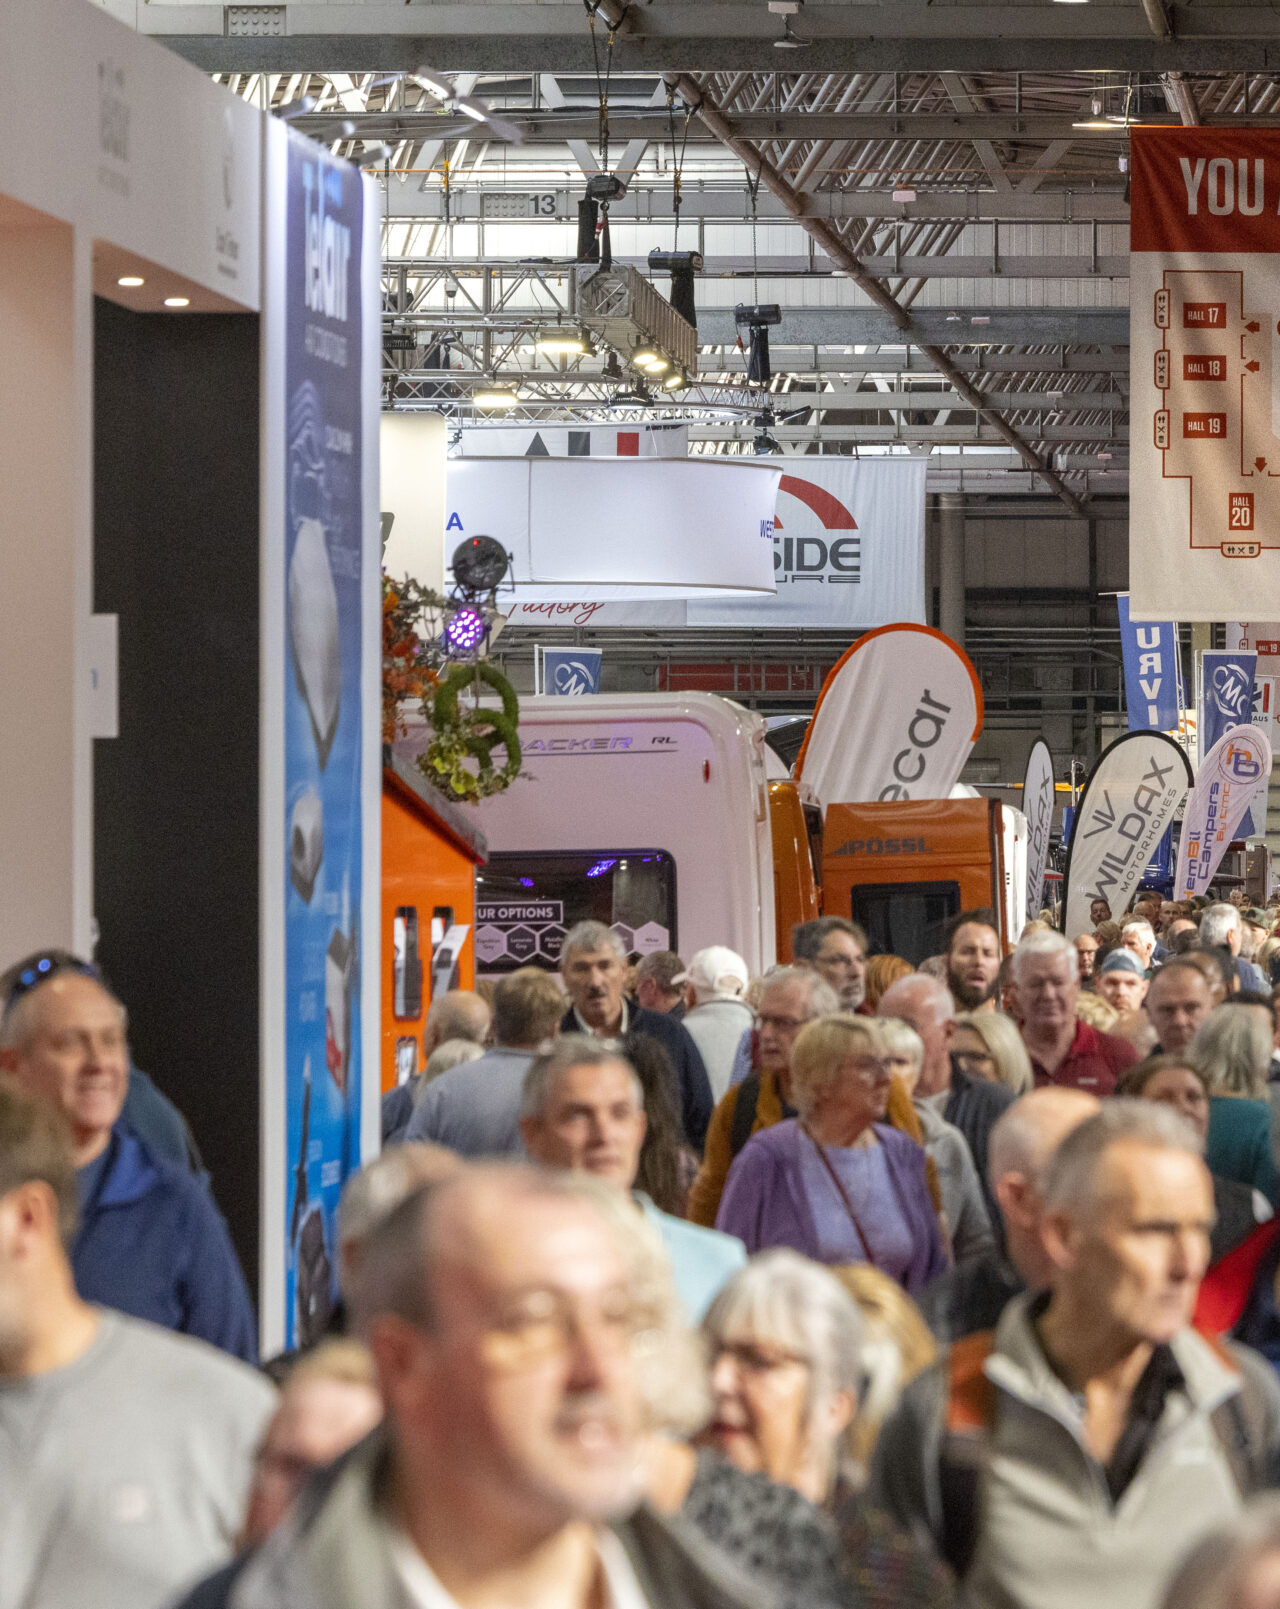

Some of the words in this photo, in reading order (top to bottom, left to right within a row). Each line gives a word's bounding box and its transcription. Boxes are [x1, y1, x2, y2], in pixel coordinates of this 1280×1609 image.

[1179, 158, 1264, 217] YOU
[528, 194, 556, 215] 13
[1187, 310, 1205, 321] HALL
[1207, 307, 1219, 323] 17
[1187, 363, 1205, 374] HALL
[1208, 360, 1221, 376] 18
[1187, 421, 1205, 432] HALL
[1208, 418, 1221, 434] 19
[1232, 496, 1250, 508] HALL
[446, 512, 464, 531] A
[1232, 508, 1250, 527] 20
[774, 537, 861, 572] IDE
[1270, 643, 1278, 653] 19
[517, 737, 634, 751] ACKER
[1085, 755, 1174, 899] WILDAX
[1197, 781, 1220, 880] Campers
[1120, 788, 1177, 893] MOTORHOMES
[476, 907, 497, 920] UR
[497, 906, 554, 919] OPTIONS
